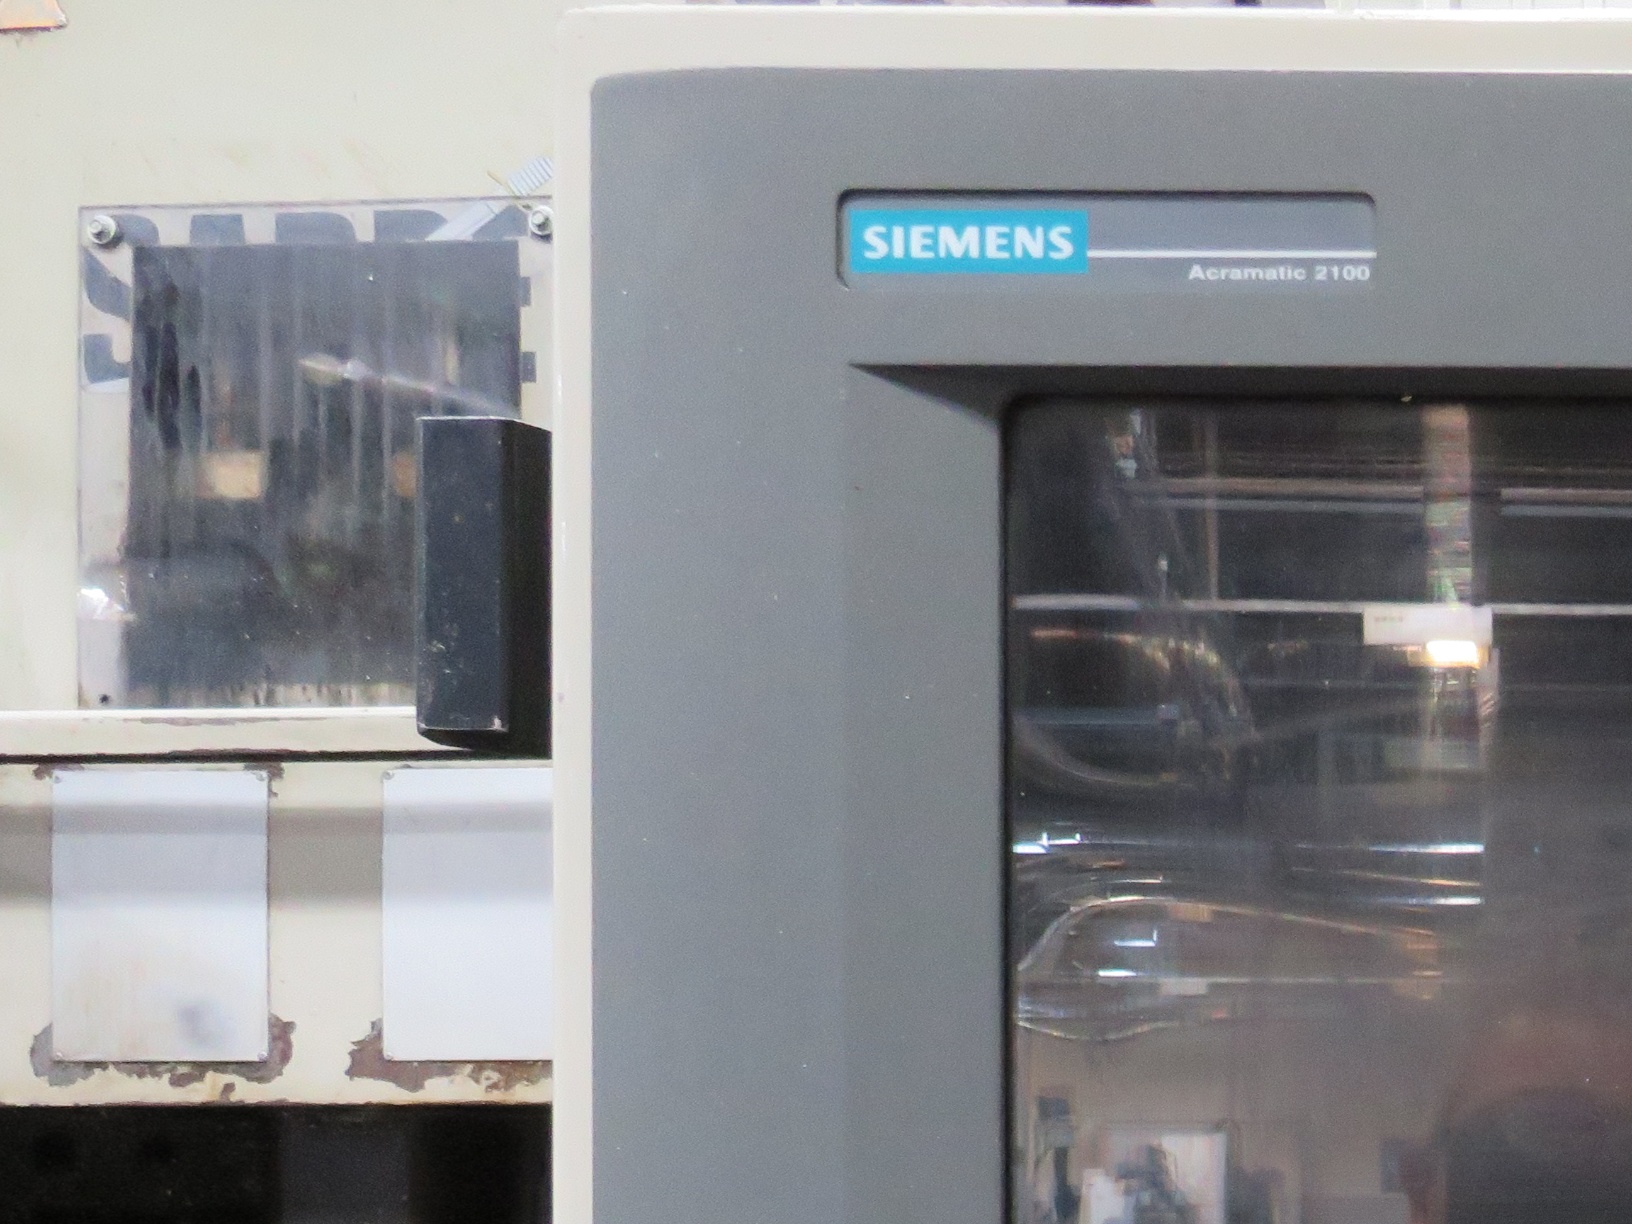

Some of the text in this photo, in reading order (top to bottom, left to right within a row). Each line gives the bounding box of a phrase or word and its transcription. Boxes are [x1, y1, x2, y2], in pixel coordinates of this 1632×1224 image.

[863, 225, 1074, 260] SIEMENS
[1188, 264, 1371, 281] Acramatic 2100
